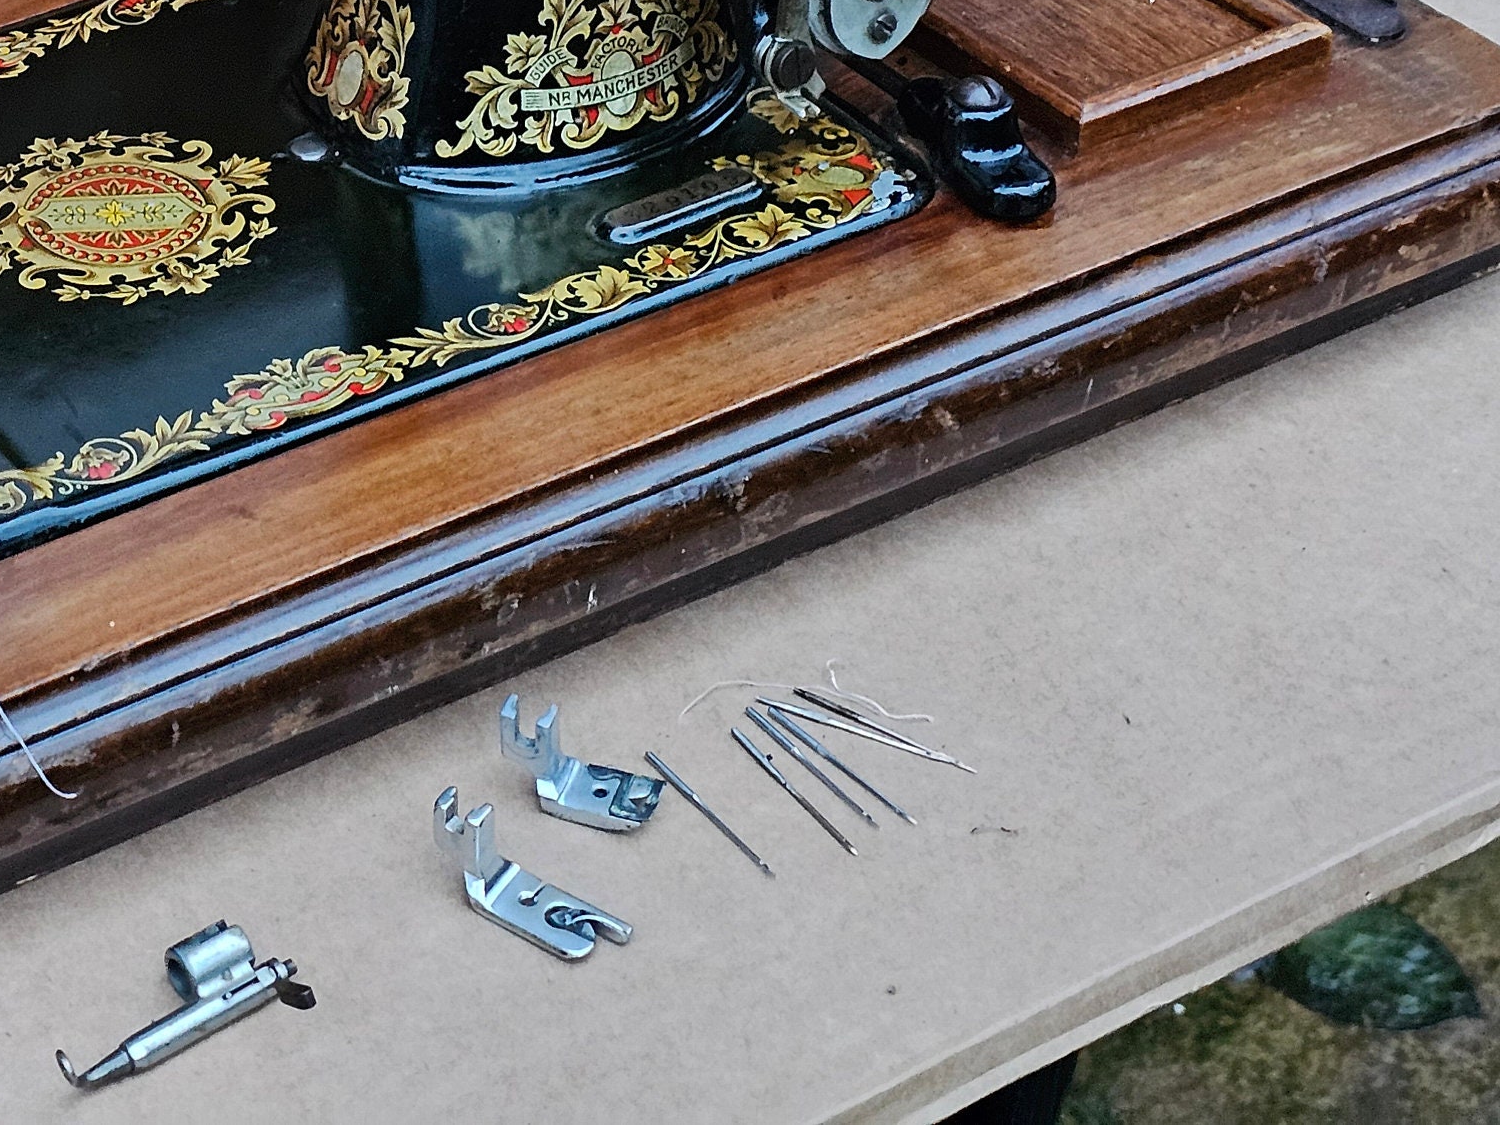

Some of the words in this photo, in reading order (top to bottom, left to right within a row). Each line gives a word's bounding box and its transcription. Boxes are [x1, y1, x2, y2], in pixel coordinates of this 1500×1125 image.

[530, 48, 567, 81] GUIDE
[590, 35, 644, 70] FACTORY
[576, 53, 679, 105] MANCHESTER
